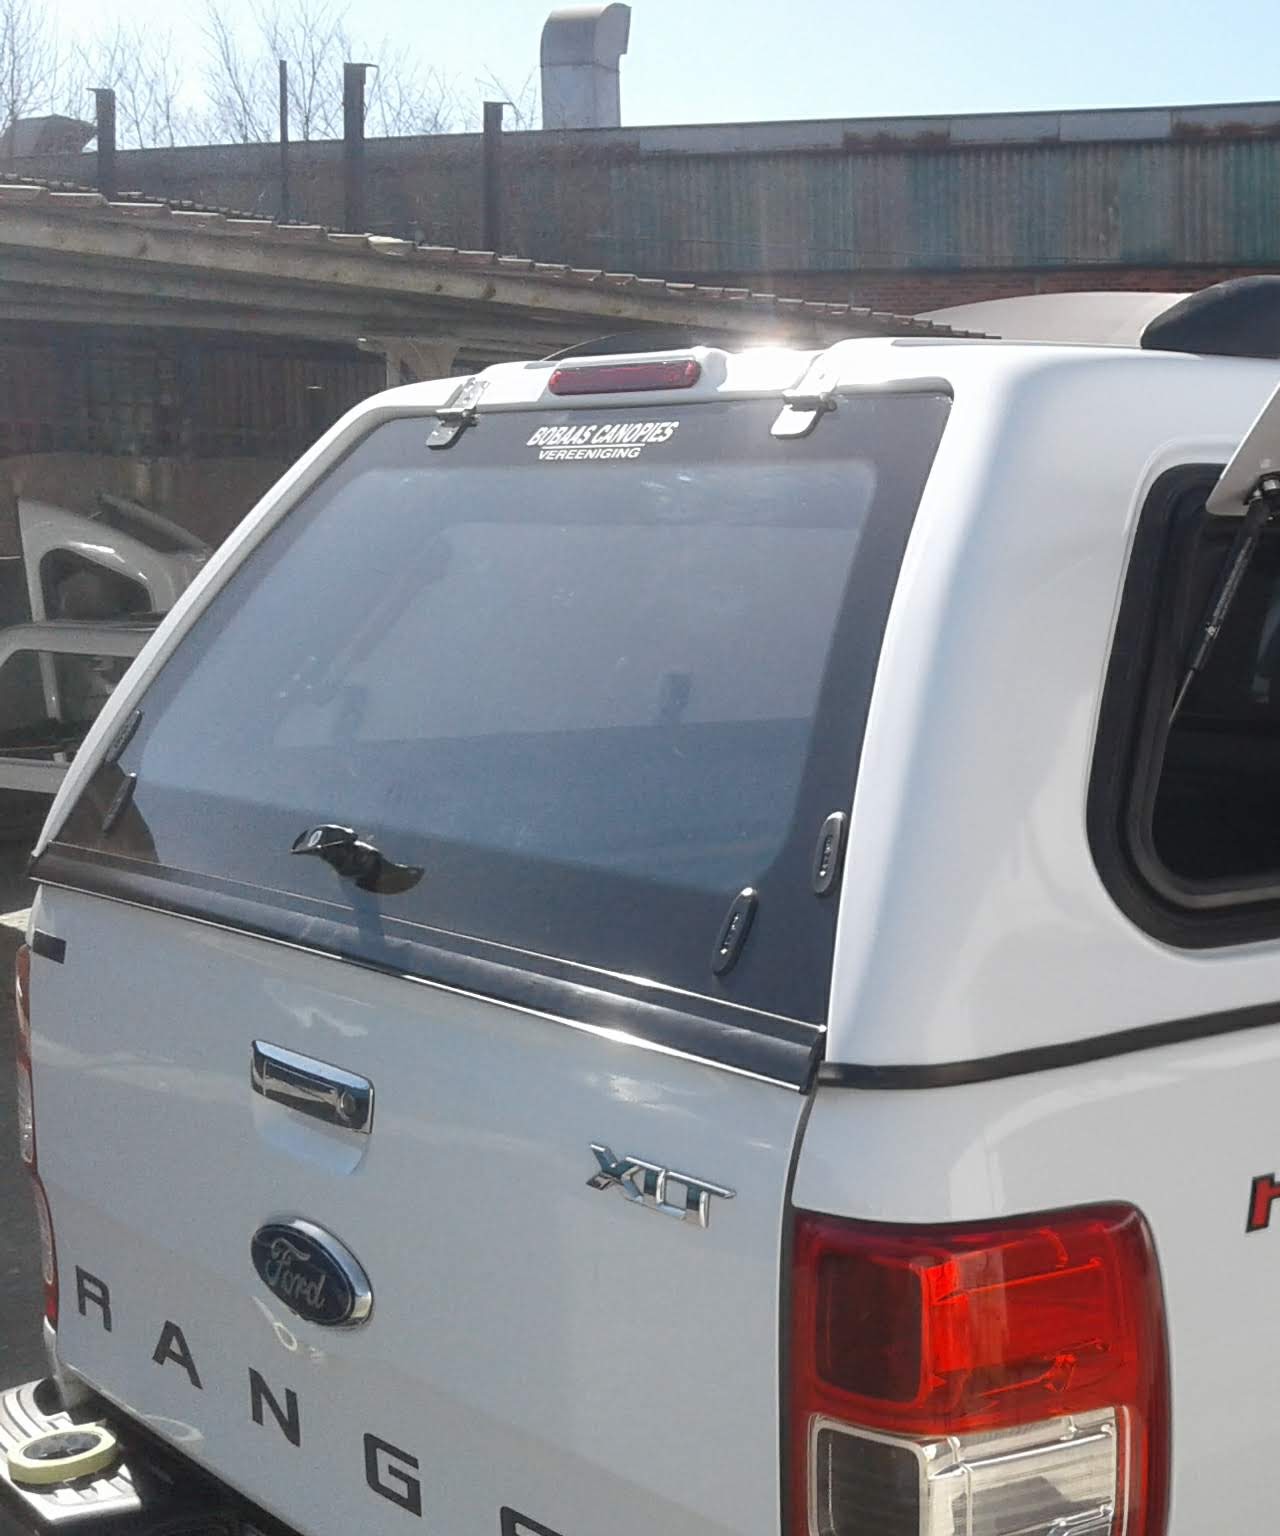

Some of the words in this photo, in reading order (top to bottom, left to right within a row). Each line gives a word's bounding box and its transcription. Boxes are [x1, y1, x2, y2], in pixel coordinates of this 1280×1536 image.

[526, 425, 595, 446] BOBAAS
[591, 421, 679, 444] CANOPIES
[538, 448, 641, 460] VEREENIGING
[585, 1143, 737, 1228] XLT
[265, 1237, 327, 1309] Ford
